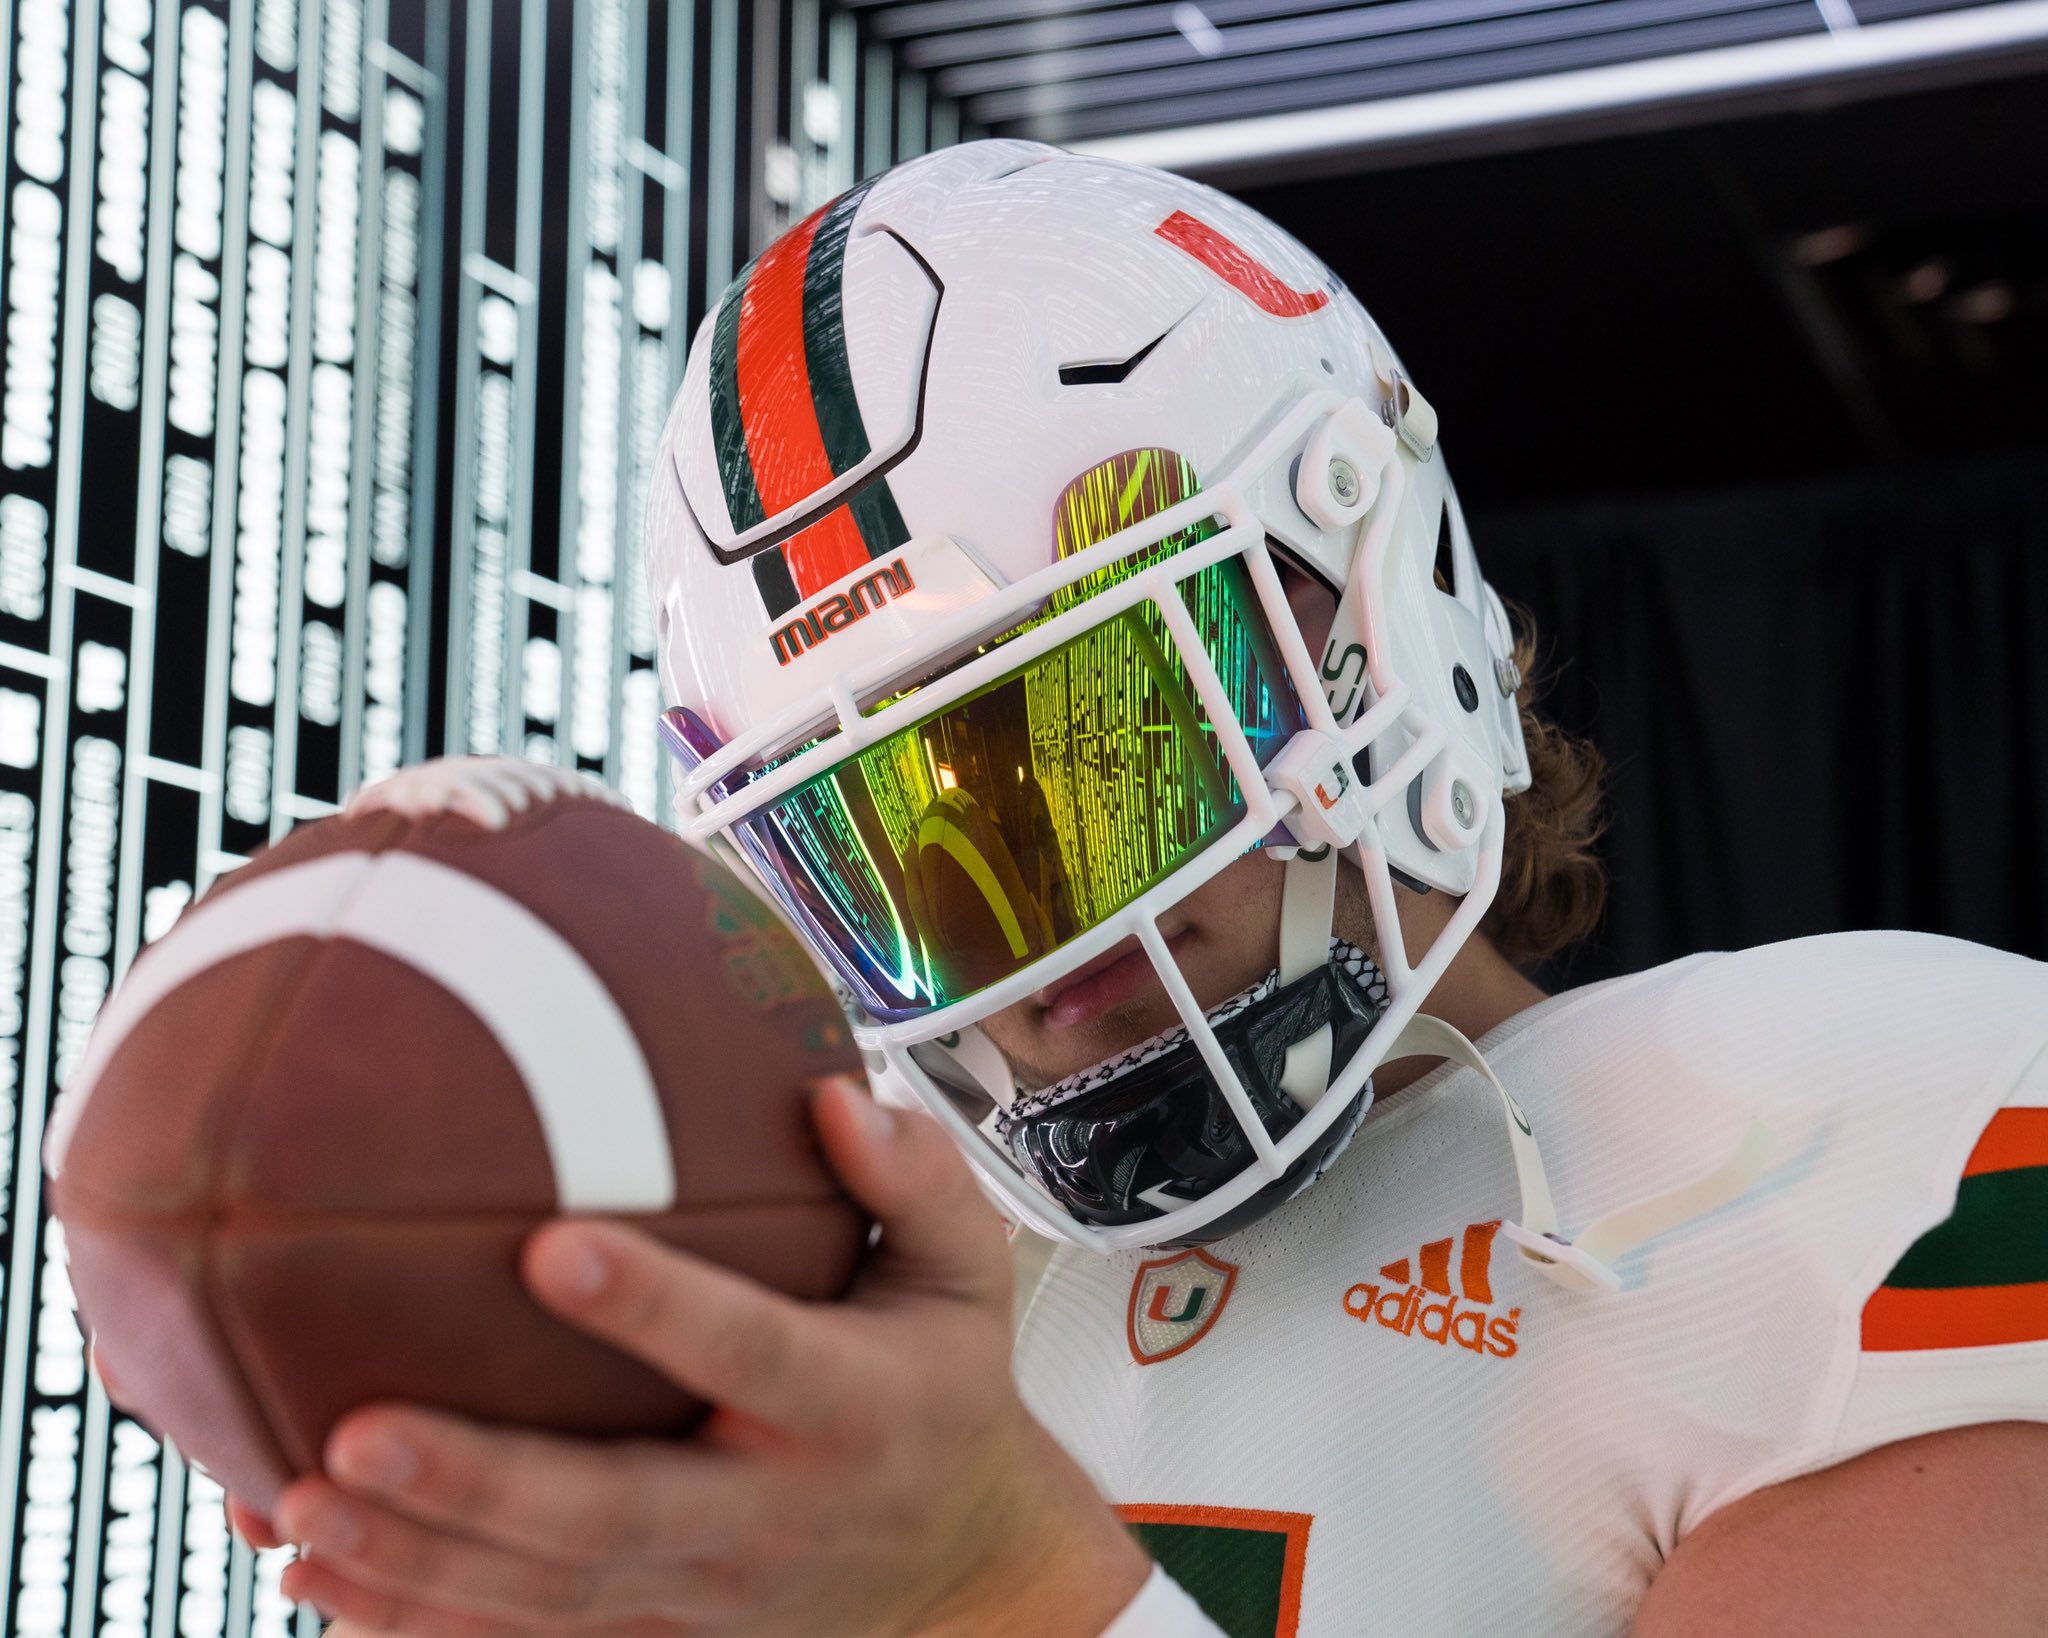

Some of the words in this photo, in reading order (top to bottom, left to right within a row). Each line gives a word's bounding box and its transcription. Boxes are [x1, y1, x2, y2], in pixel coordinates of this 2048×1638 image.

[1147, 1284, 1206, 1323] U
[1343, 1283, 1519, 1358] adidas
[16, 1404, 82, 1638] DRICK
